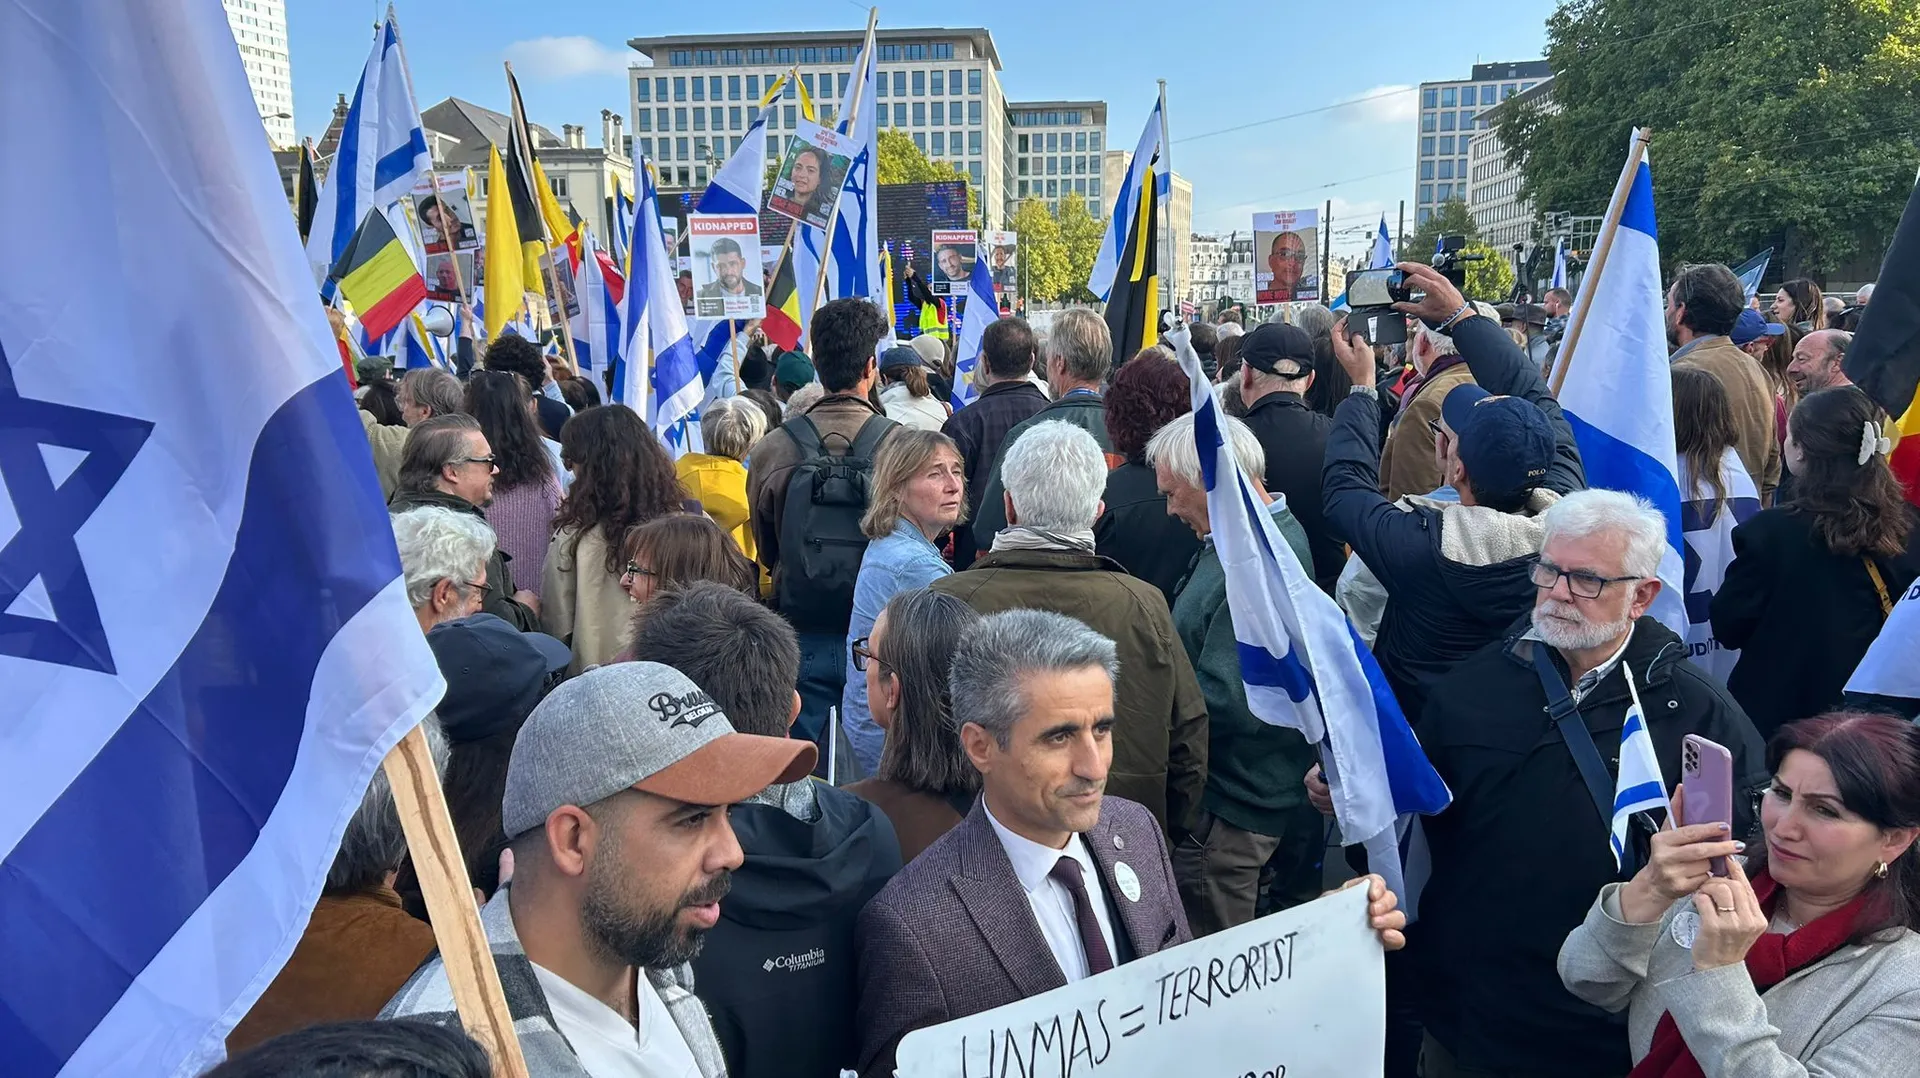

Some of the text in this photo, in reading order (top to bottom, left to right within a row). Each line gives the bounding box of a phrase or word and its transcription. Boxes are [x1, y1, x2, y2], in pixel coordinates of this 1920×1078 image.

[694, 221, 754, 231] KIDNAPPED
[1527, 468, 1547, 477] POLO
[775, 947, 824, 968] Columbia
[788, 957, 825, 972] TITANIUM
[961, 999, 1111, 1078] HAMAS
[1155, 931, 1299, 1025] TERRORIST
